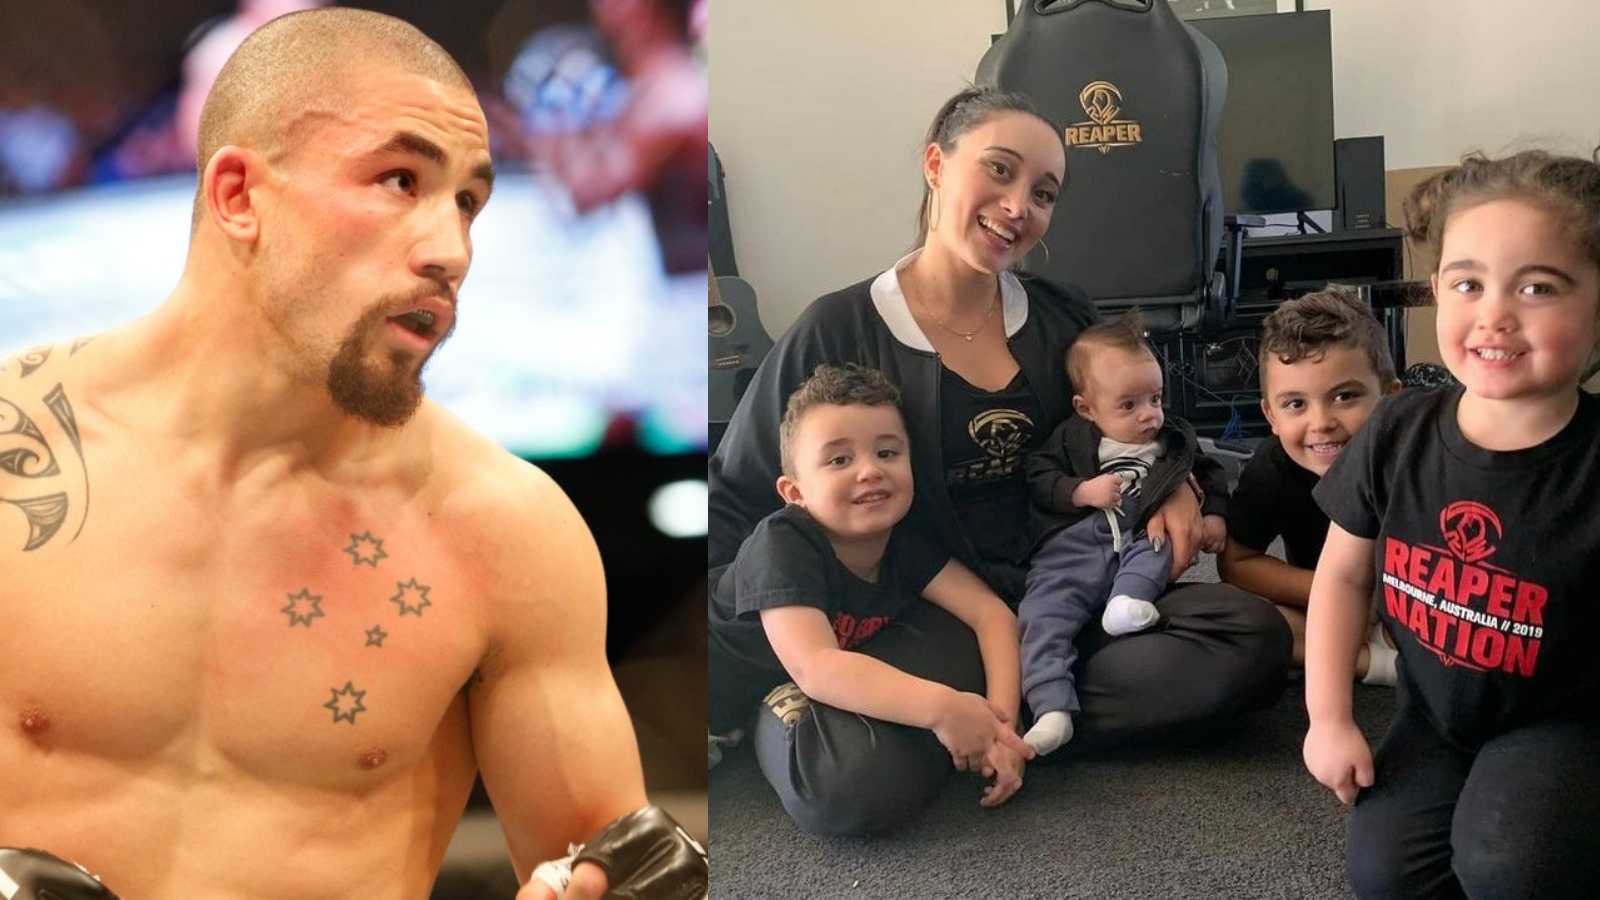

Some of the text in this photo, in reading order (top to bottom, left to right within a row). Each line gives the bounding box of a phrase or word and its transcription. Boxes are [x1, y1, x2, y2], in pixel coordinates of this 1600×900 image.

[1065, 124, 1143, 144] REAPER
[1383, 573, 1438, 609] MELBOURNE,
[1439, 600, 1498, 629] AUSTRALIA
[1512, 622, 1543, 638] 2019
[1384, 536, 1548, 625] REAPER
[1384, 586, 1541, 676] NATION
